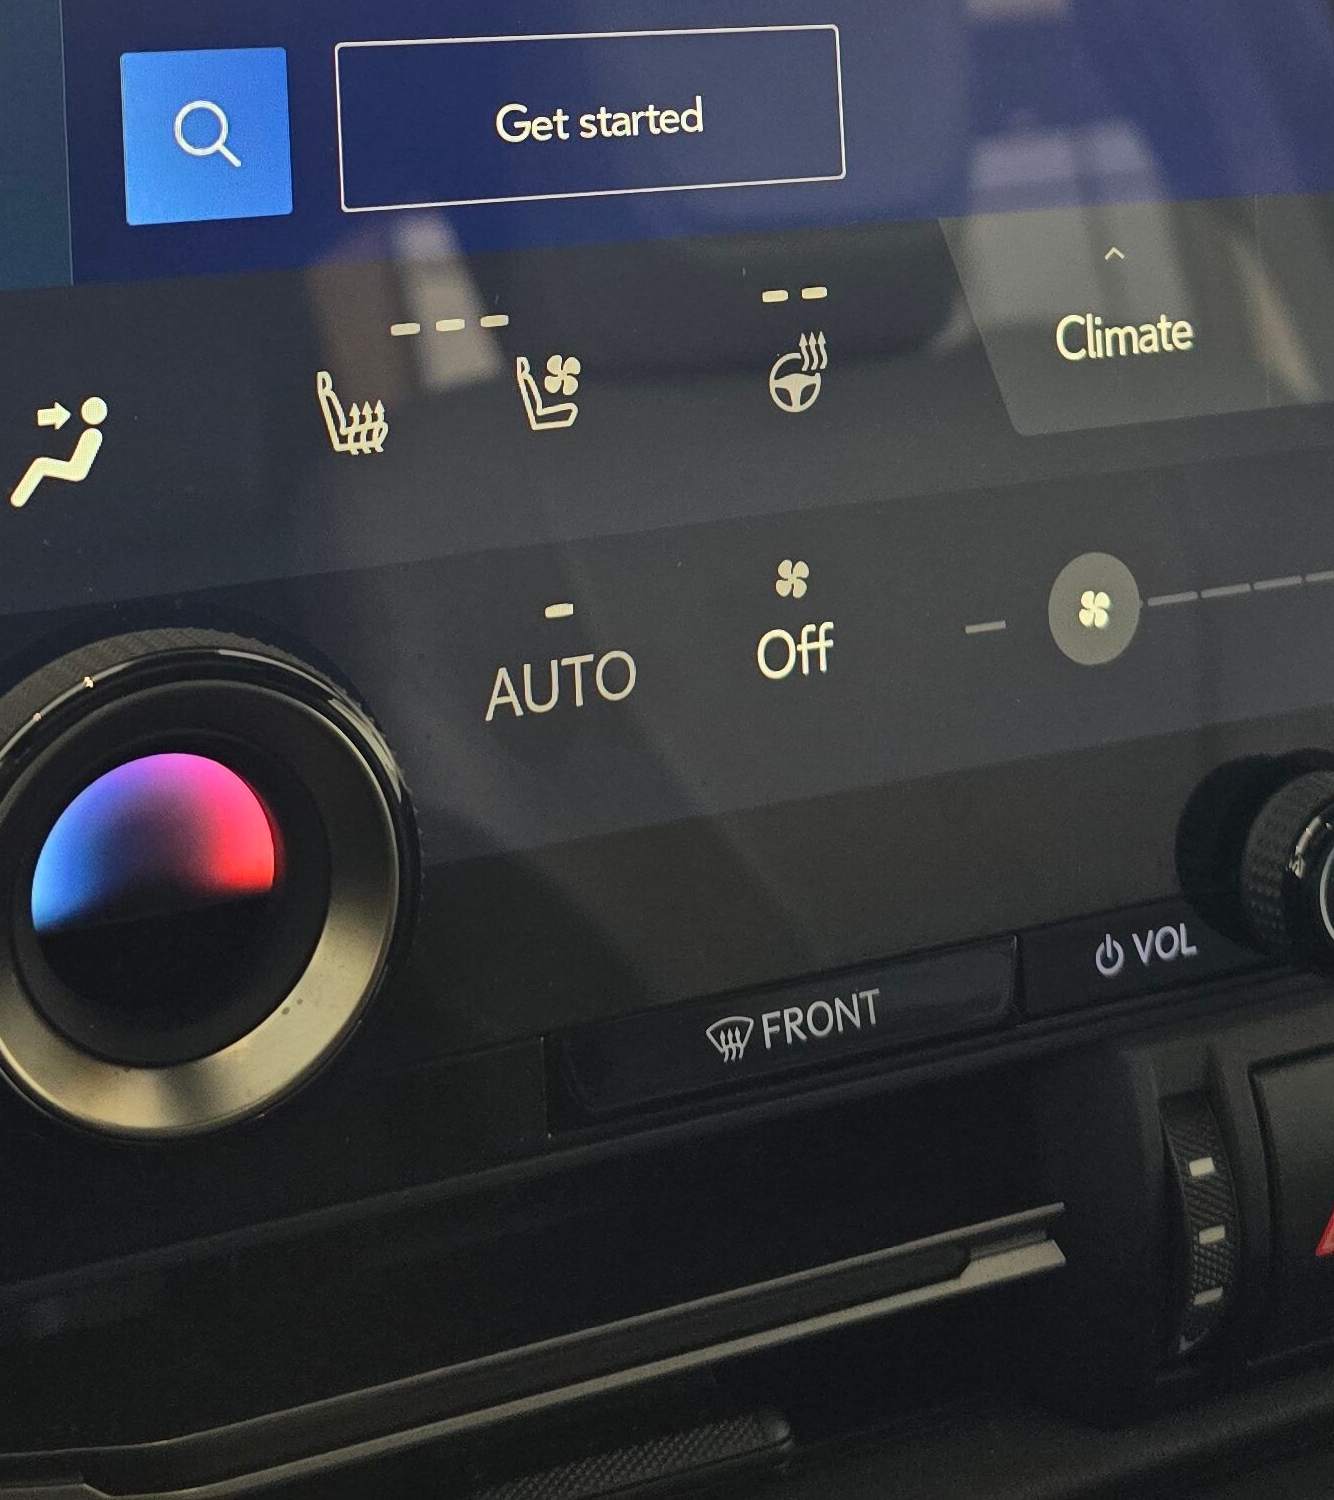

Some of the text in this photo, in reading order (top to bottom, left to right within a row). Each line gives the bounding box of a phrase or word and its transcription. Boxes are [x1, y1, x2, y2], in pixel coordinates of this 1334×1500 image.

[495, 94, 705, 144] Get started
[1055, 312, 1195, 362] Climate
[756, 620, 835, 681] Off
[484, 649, 638, 723] AUTO
[1131, 922, 1199, 967] VOL
[760, 986, 881, 1050] FRONT
